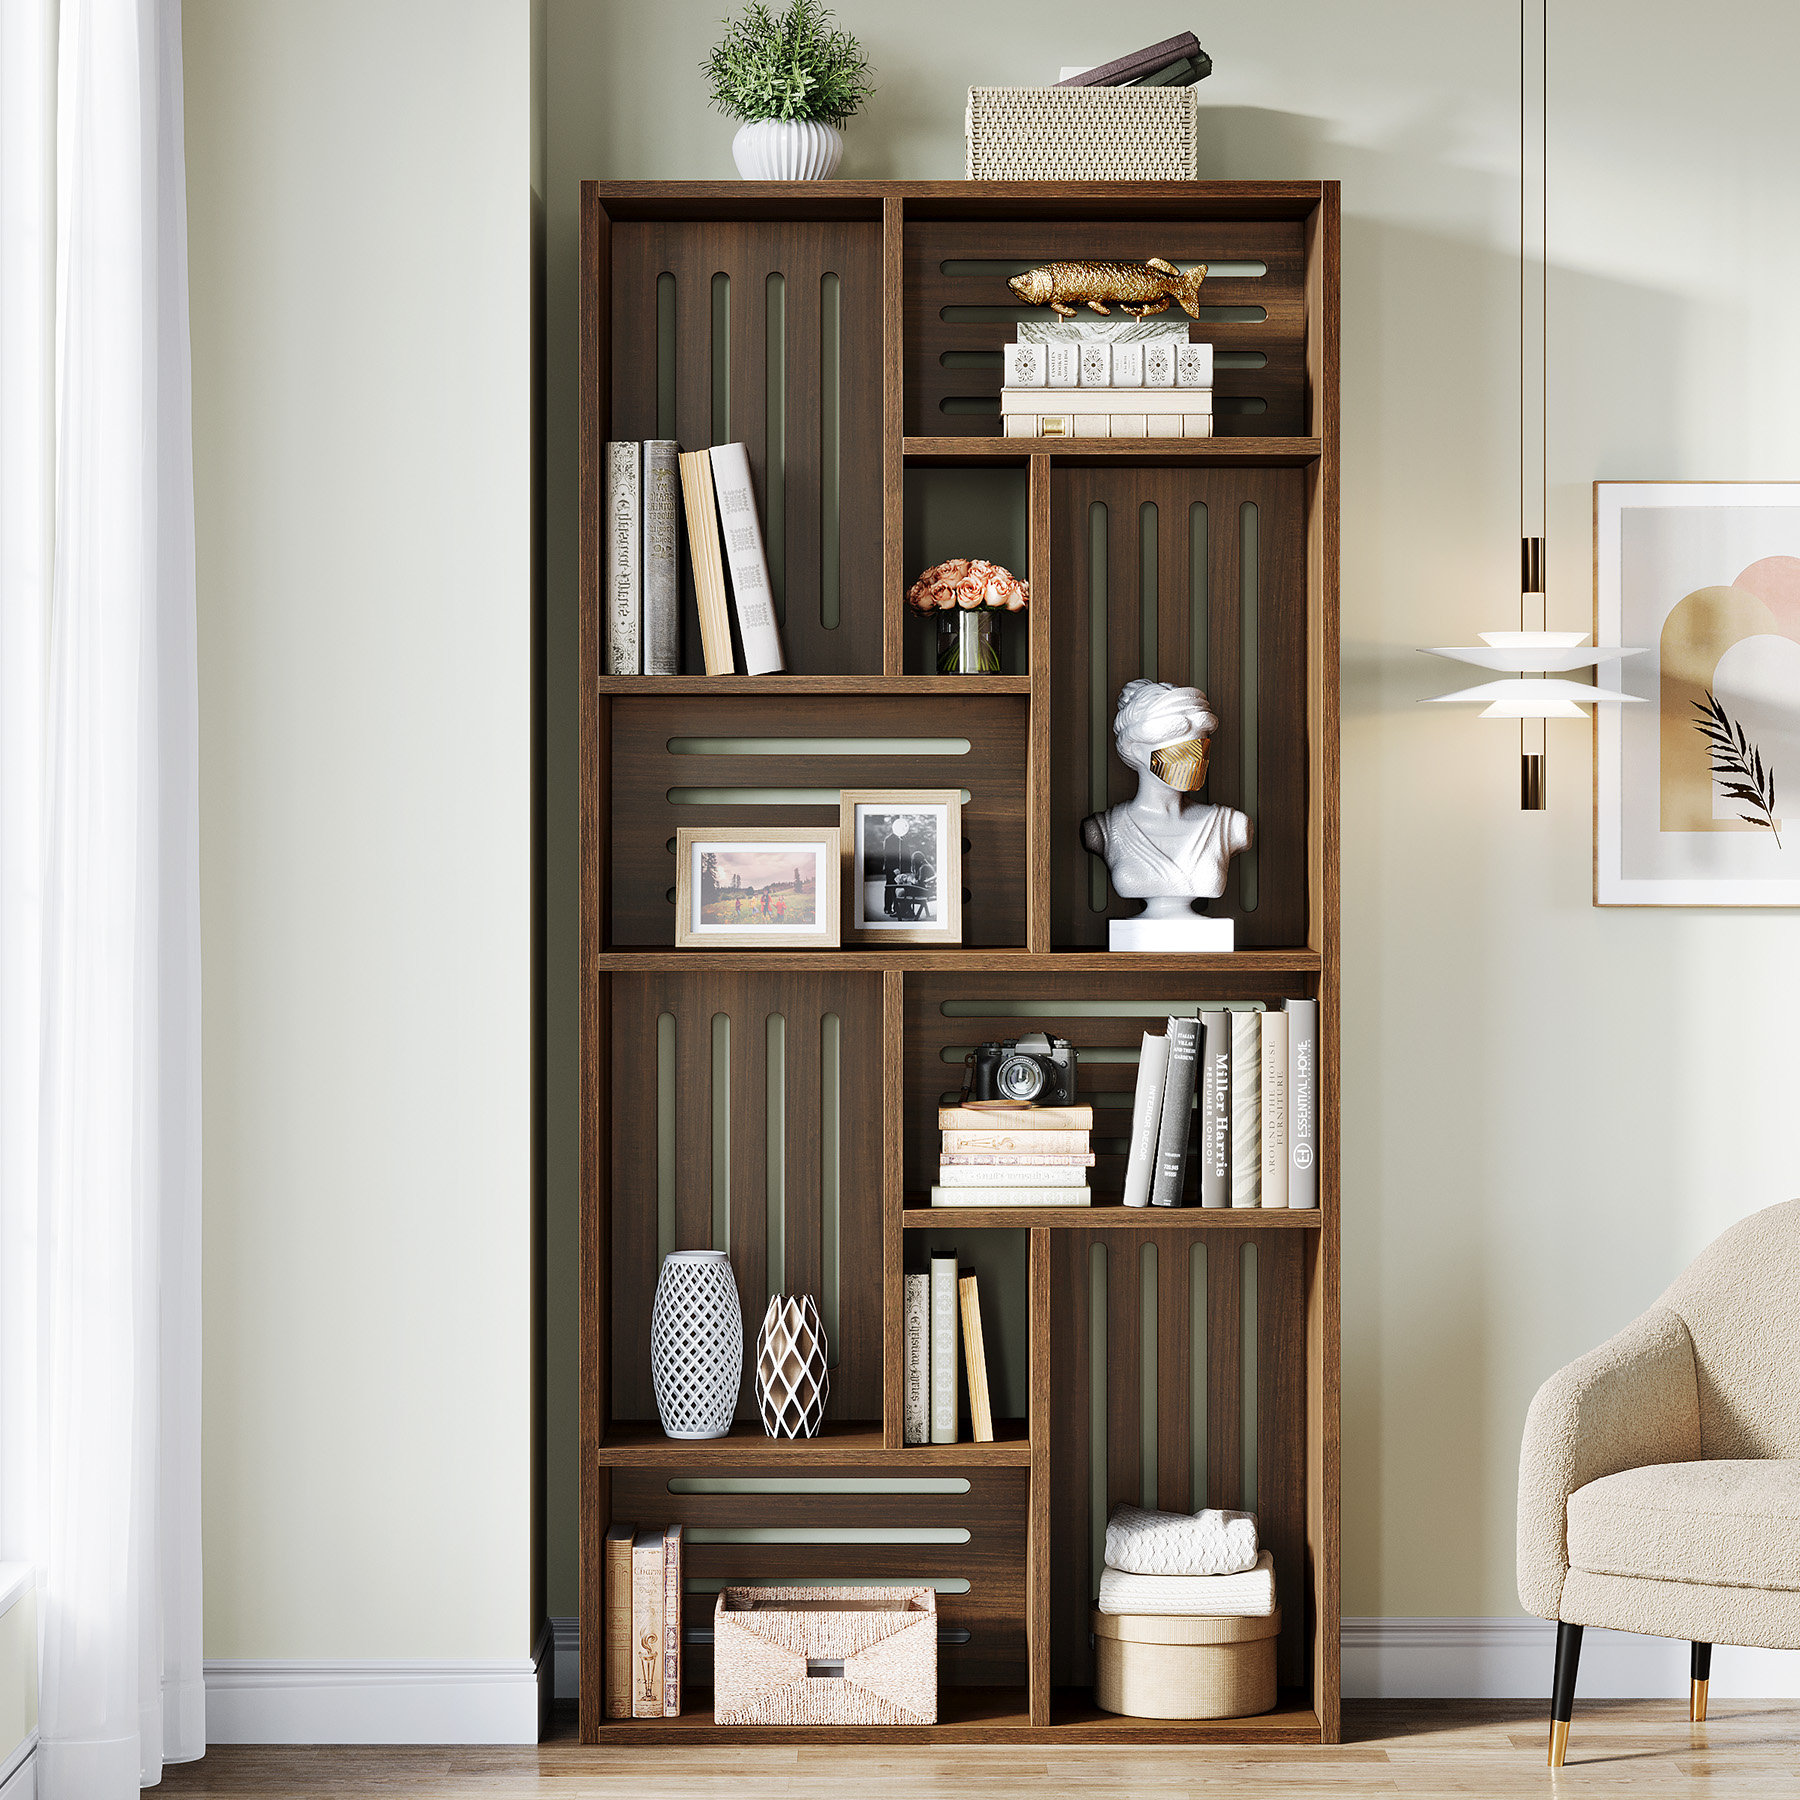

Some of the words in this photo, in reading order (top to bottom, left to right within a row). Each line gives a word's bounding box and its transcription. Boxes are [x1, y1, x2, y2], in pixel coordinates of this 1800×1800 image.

[1268, 1040, 1276, 1084] HOUSE
[1297, 1040, 1308, 1078] HOME
[1216, 1053, 1228, 1112] Miller
[1268, 1090, 1276, 1115] THE
[1143, 1085, 1156, 1128] INTERIOR
[1276, 1070, 1284, 1145] FURNITURE
[1297, 1080, 1308, 1138] ESSENTIAL
[1138, 1129, 1150, 1161] DECOR
[1216, 1116, 1228, 1178] Harris
[1268, 1120, 1276, 1176] AROUND
[910, 1316, 922, 1366] Christian
[909, 1366, 922, 1402] Lyrics
[634, 1566, 662, 1575] Charm
